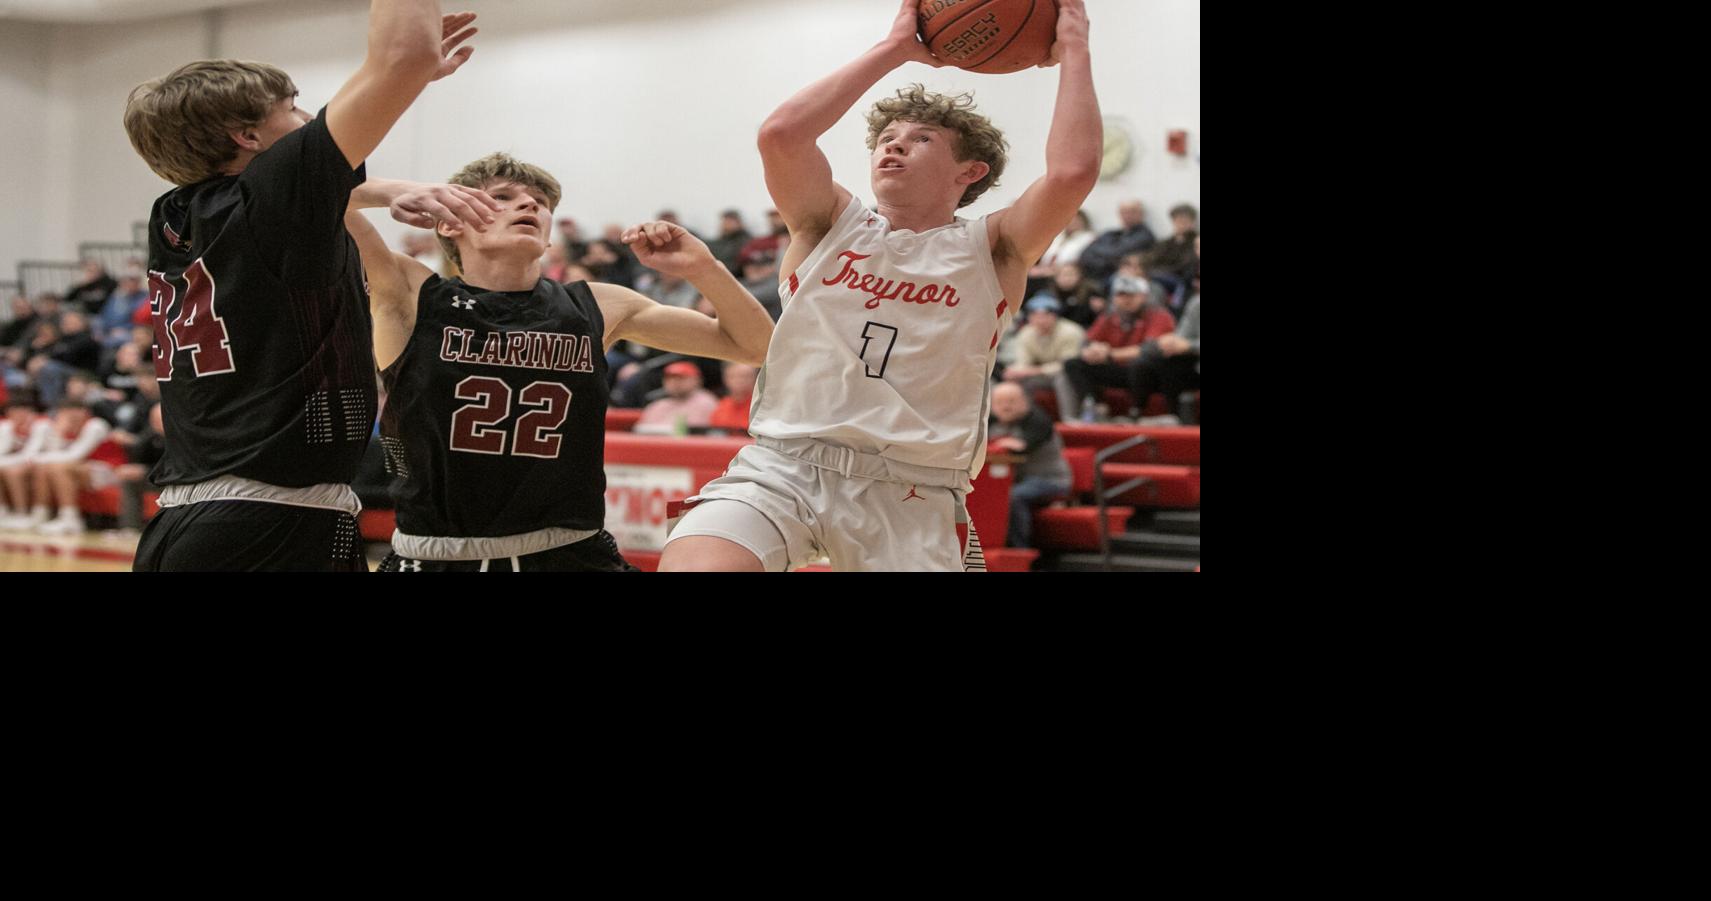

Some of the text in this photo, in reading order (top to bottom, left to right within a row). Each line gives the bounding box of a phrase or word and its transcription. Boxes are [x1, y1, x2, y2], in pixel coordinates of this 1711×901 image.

[822, 250, 961, 310] Treynor
[147, 257, 236, 382] 34
[439, 326, 594, 373] CLARINDA
[859, 321, 898, 379] 1
[450, 375, 573, 459] 22
